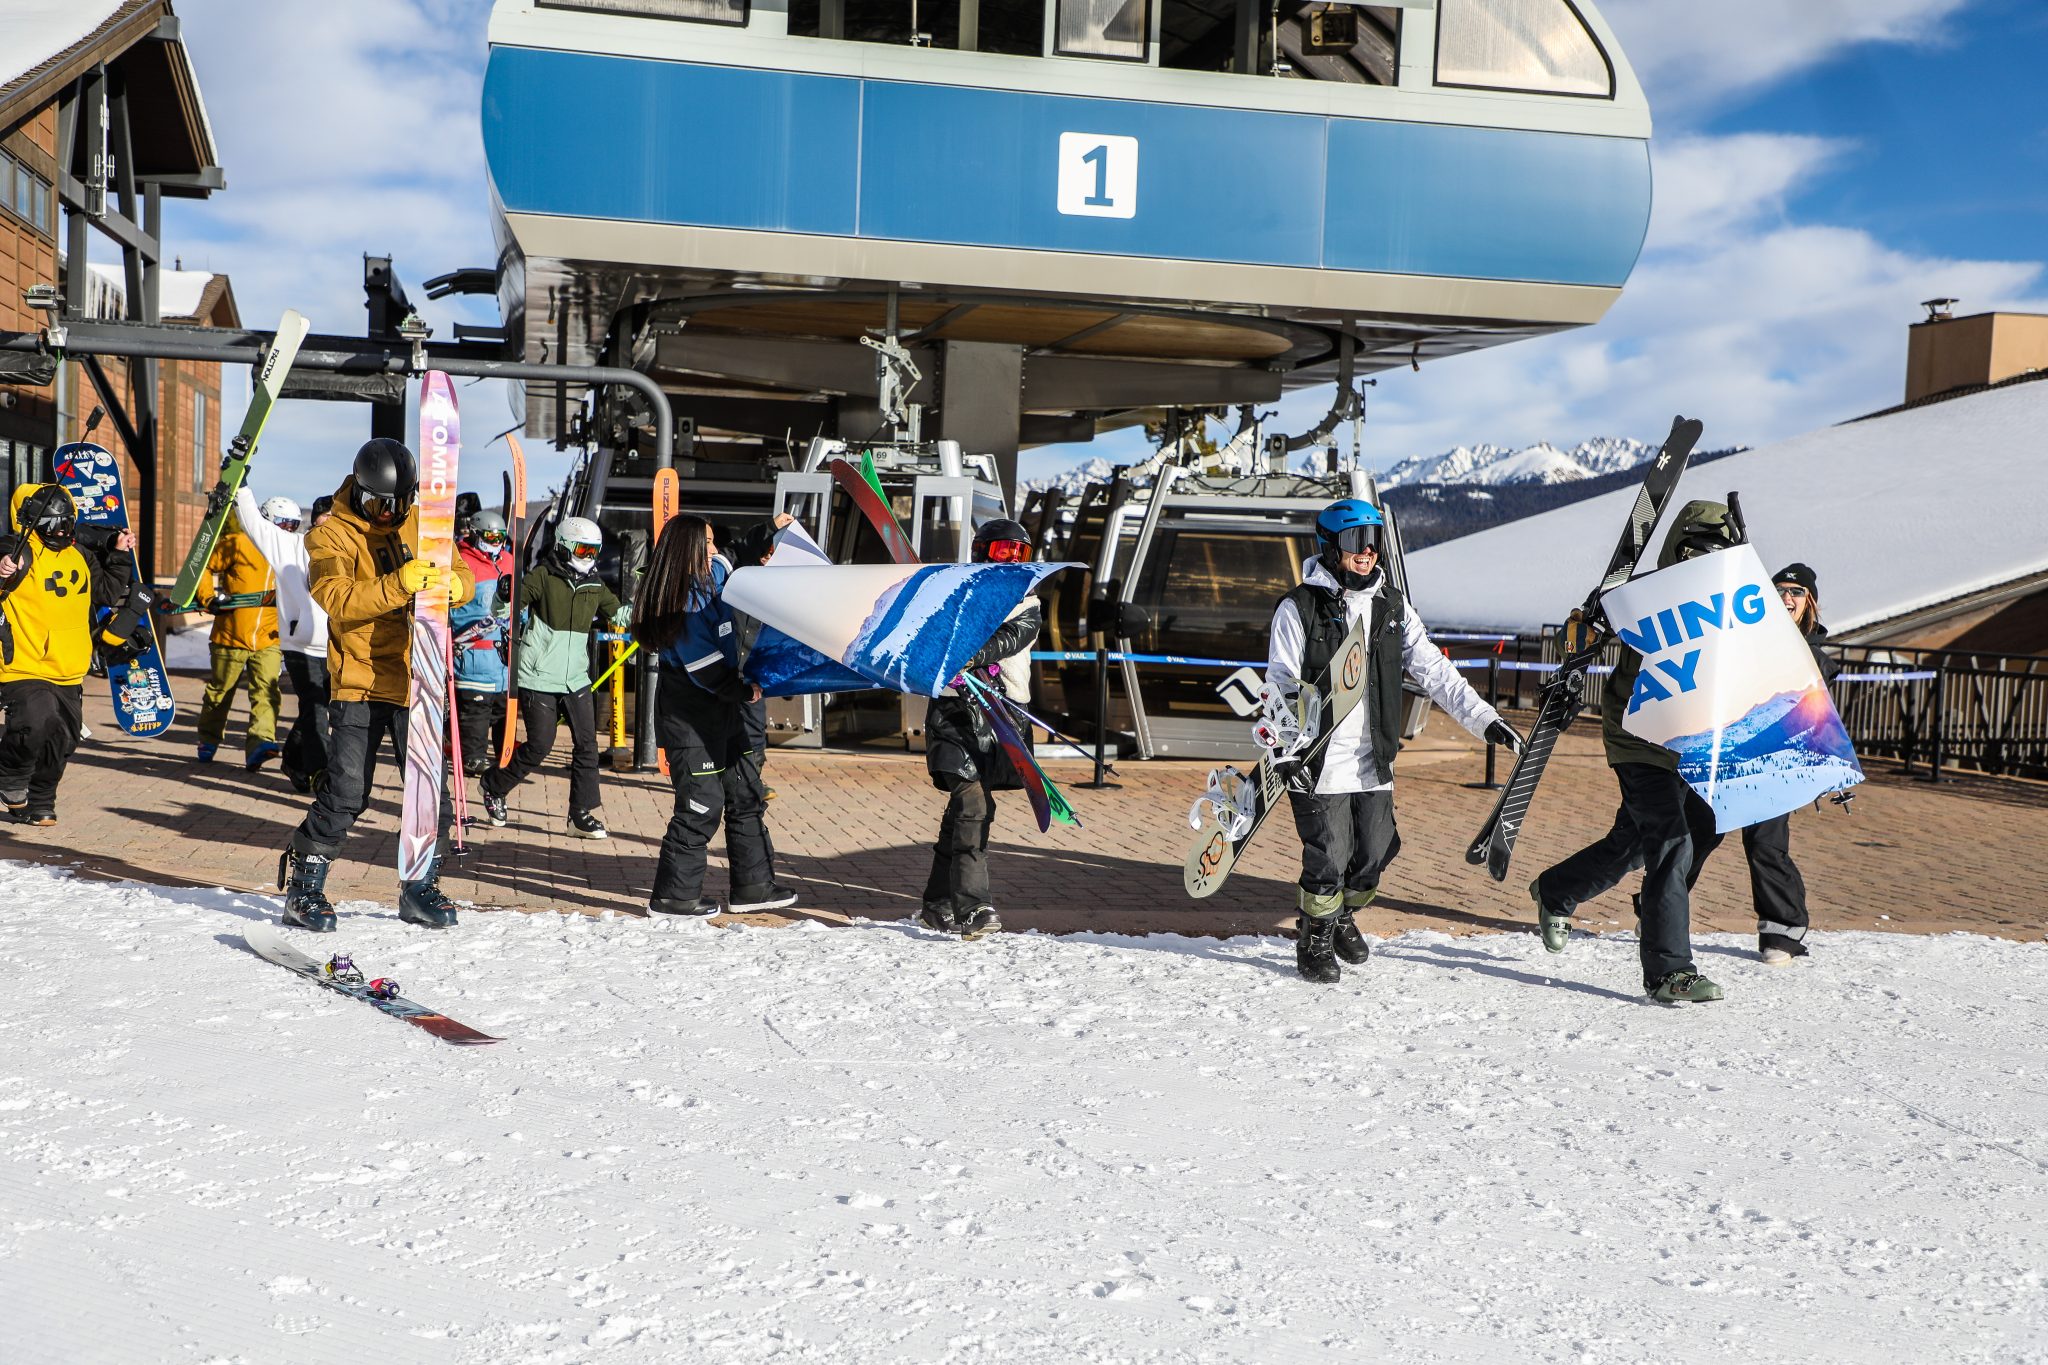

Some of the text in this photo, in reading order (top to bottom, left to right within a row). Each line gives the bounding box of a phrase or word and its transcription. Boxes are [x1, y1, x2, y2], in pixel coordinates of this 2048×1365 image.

[1082, 144, 1114, 207] 1
[262, 348, 280, 382] FACTION
[431, 391, 448, 496] ATOMIC
[876, 451, 888, 460] 69
[1071, 652, 1087, 660] VAIL
[1628, 648, 1702, 716] AY
[702, 761, 715, 770] HH
